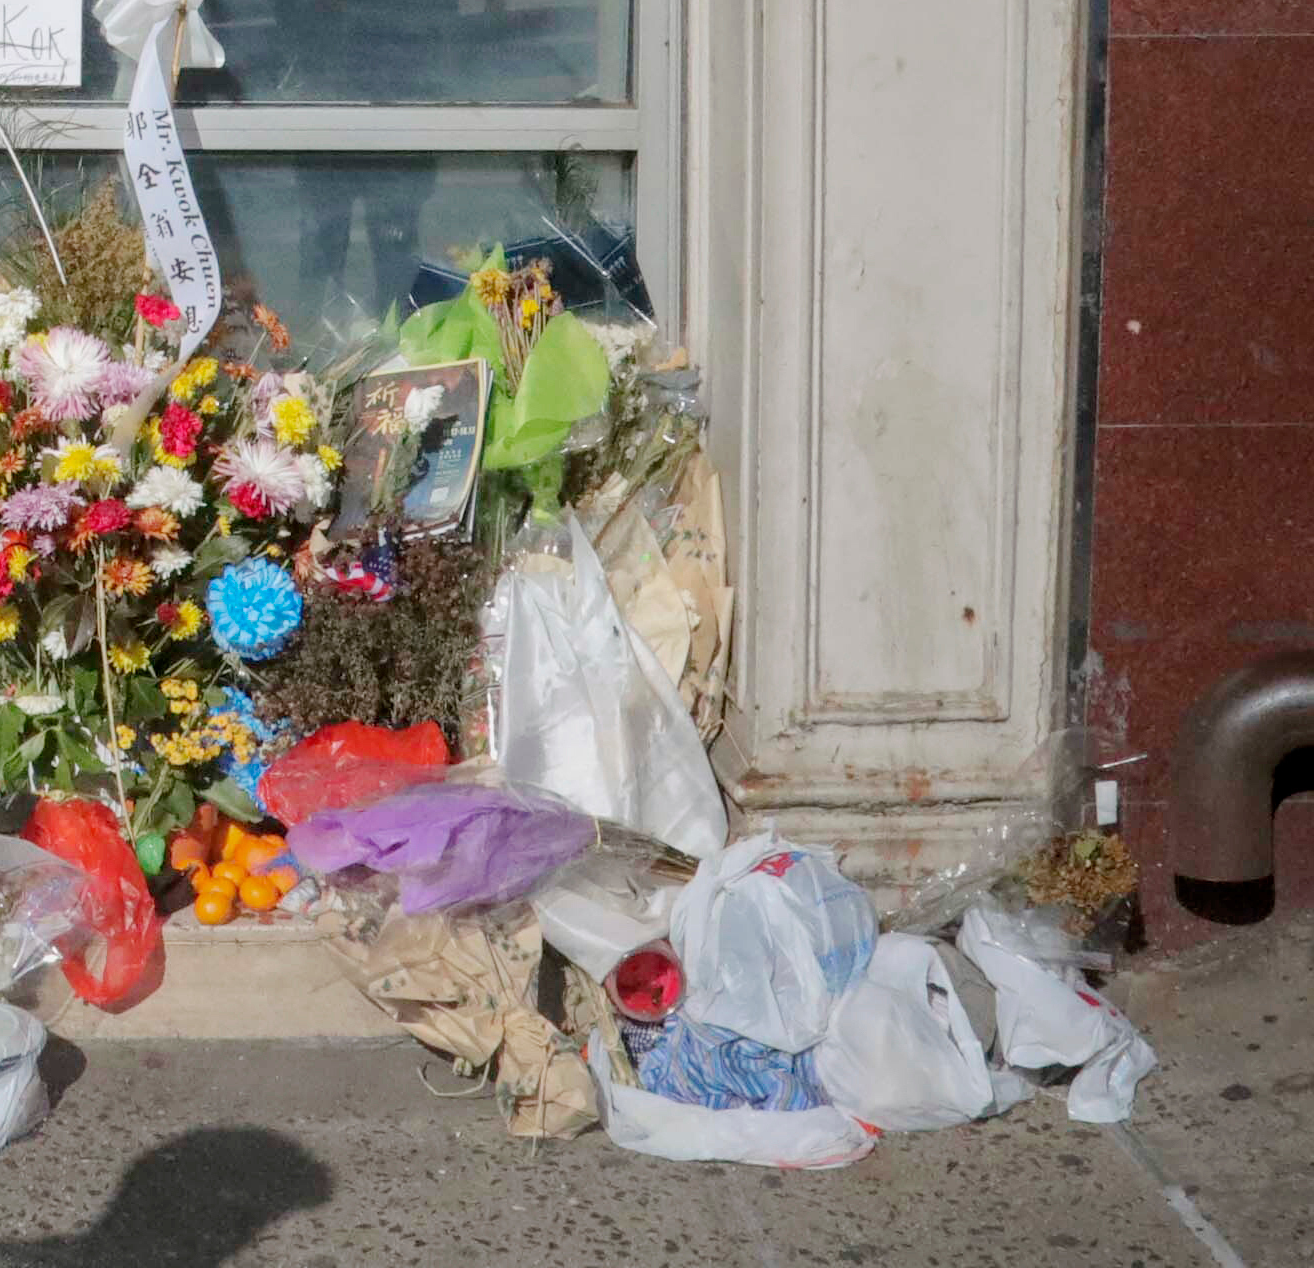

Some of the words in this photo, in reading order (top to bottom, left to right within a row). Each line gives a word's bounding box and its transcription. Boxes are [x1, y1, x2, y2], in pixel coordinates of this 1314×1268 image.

[152, 108, 172, 152] Mr.
[165, 158, 201, 229] Kwok
[190, 233, 217, 310] Chuen
